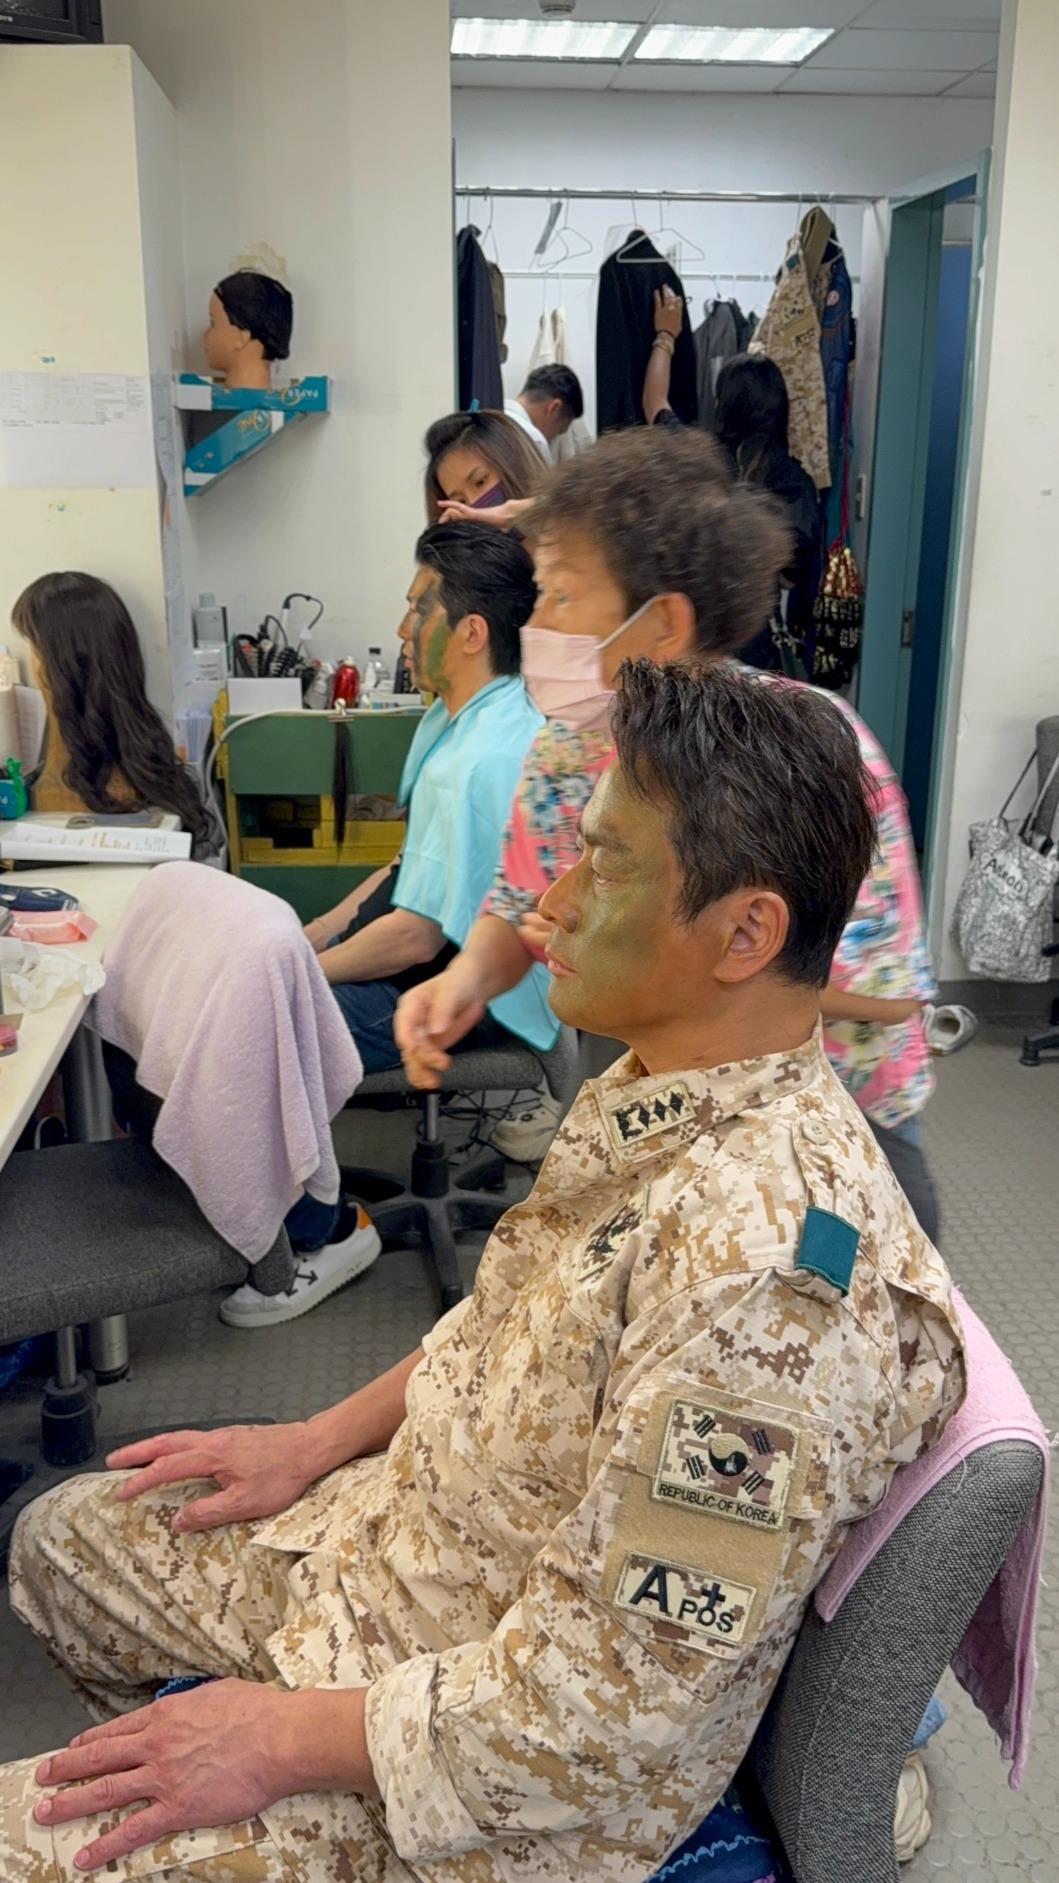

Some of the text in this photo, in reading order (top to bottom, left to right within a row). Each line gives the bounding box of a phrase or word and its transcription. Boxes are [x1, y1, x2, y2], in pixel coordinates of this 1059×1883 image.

[660, 1484, 778, 1525] REPUBLIC OF KOREA
